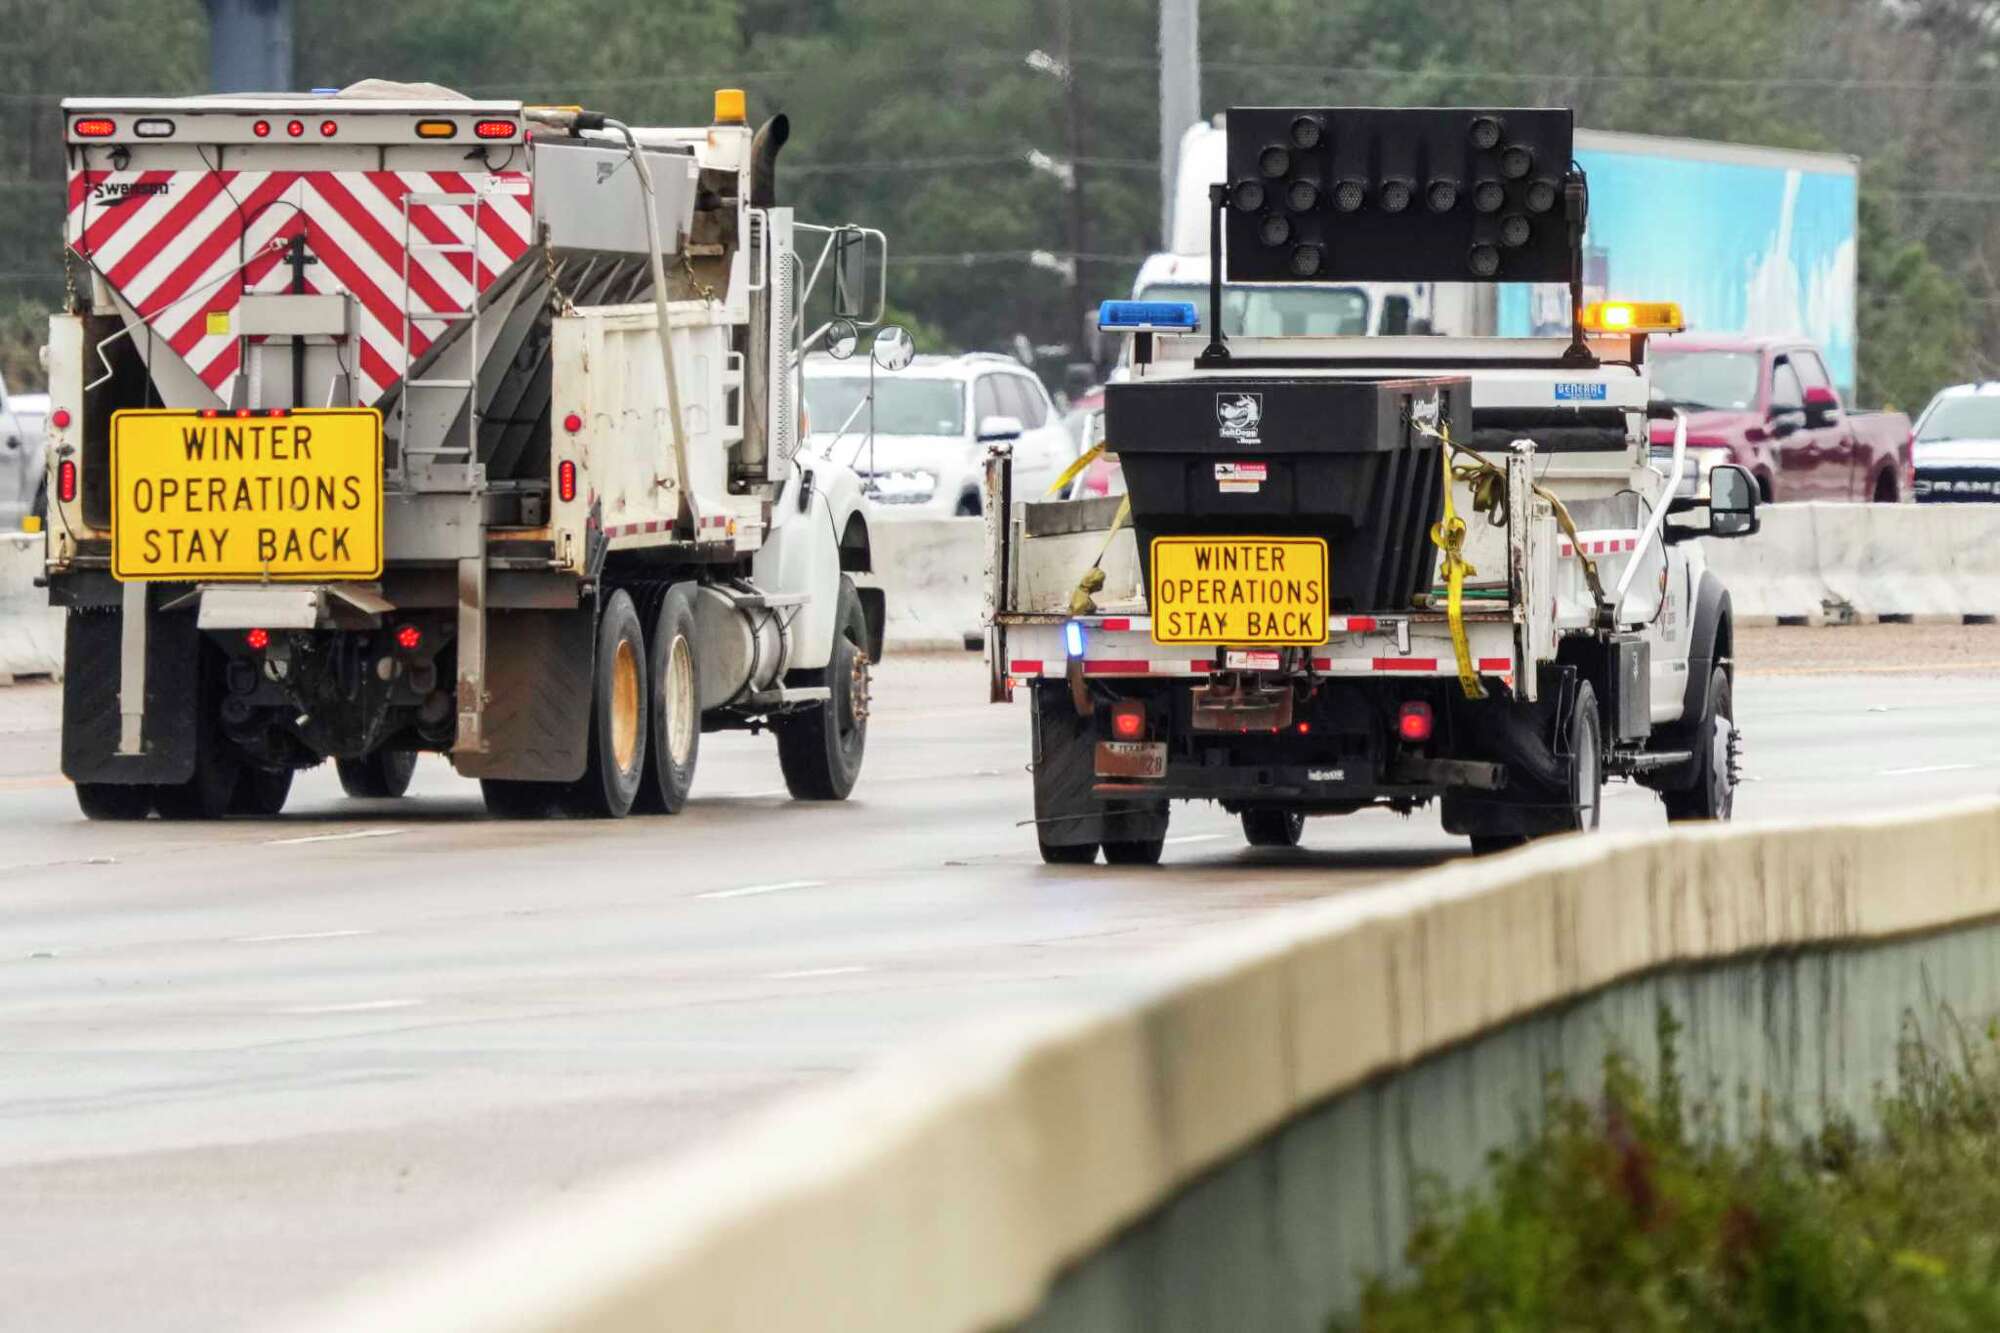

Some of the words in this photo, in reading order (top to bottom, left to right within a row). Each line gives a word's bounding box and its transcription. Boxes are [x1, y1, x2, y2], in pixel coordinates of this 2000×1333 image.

[182, 426, 313, 461] WINTER
[133, 475, 361, 513] OPERATIONS
[143, 529, 230, 563] STAY
[258, 527, 351, 563] BACK
[1194, 547, 1286, 572] WINTER
[1161, 579, 1319, 605] OPERATIONS
[1168, 612, 1228, 637] STAY
[1247, 612, 1313, 637] BACK
